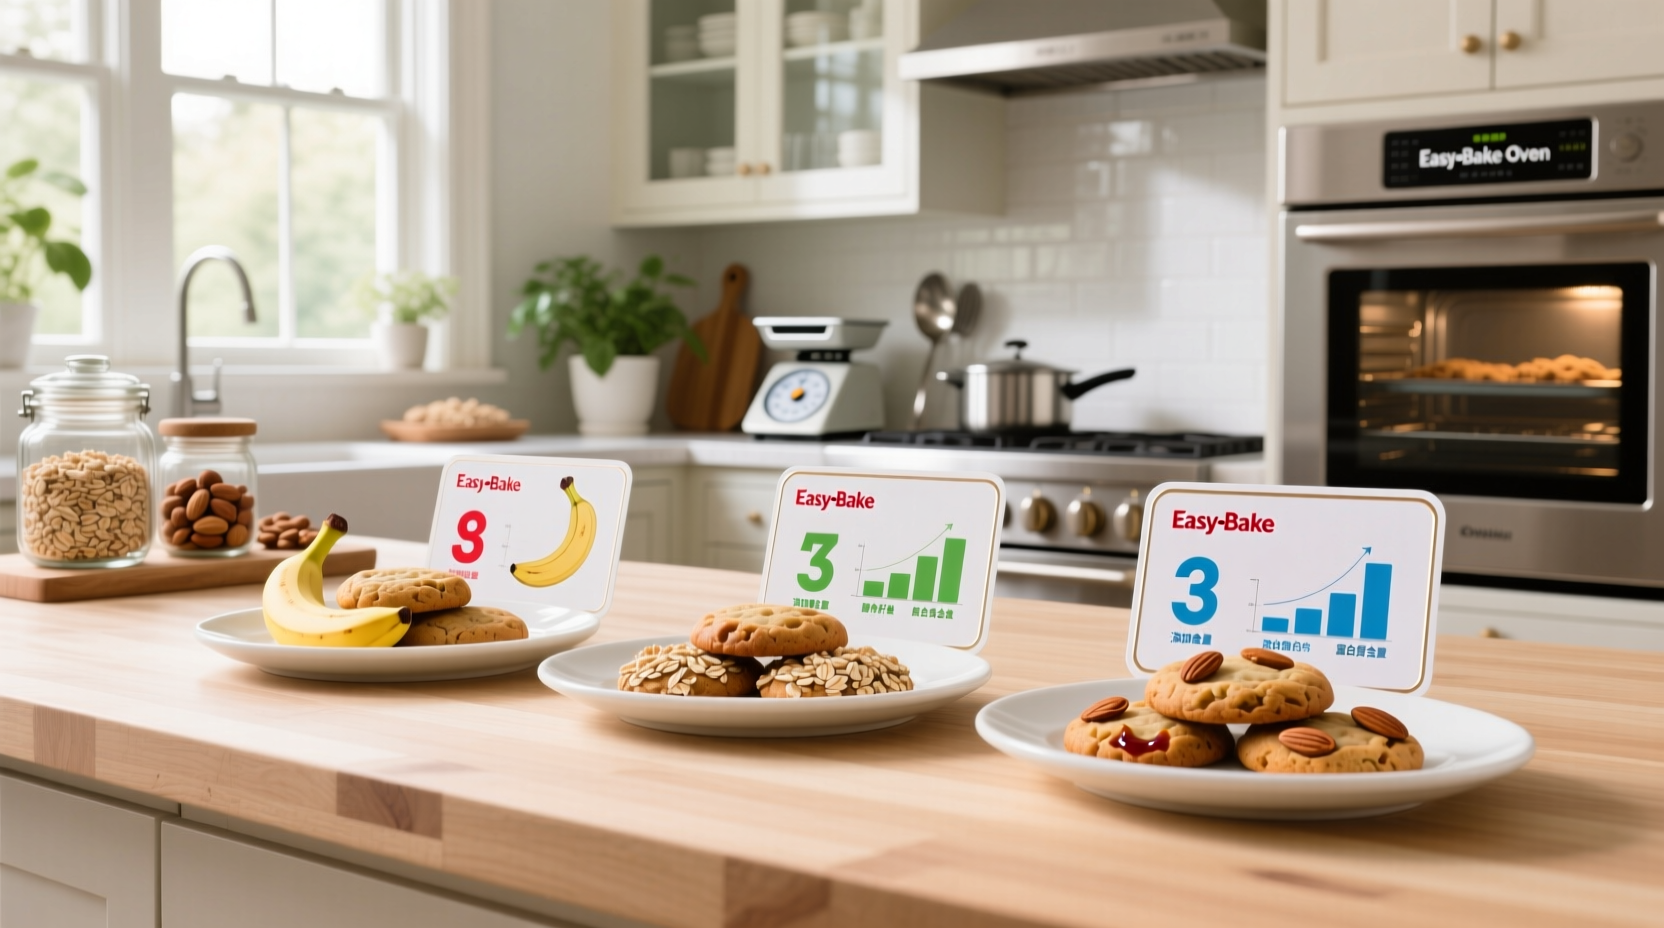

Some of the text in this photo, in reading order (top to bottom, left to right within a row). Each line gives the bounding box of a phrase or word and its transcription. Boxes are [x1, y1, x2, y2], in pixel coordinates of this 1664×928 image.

[1418, 145, 1504, 171] Easy-Bake
[1504, 144, 1551, 164] Oven
[795, 488, 875, 511] Easy-Bake
[1172, 509, 1275, 535] Easy-Bake
[796, 532, 839, 592] 3
[1171, 556, 1219, 626] 3
